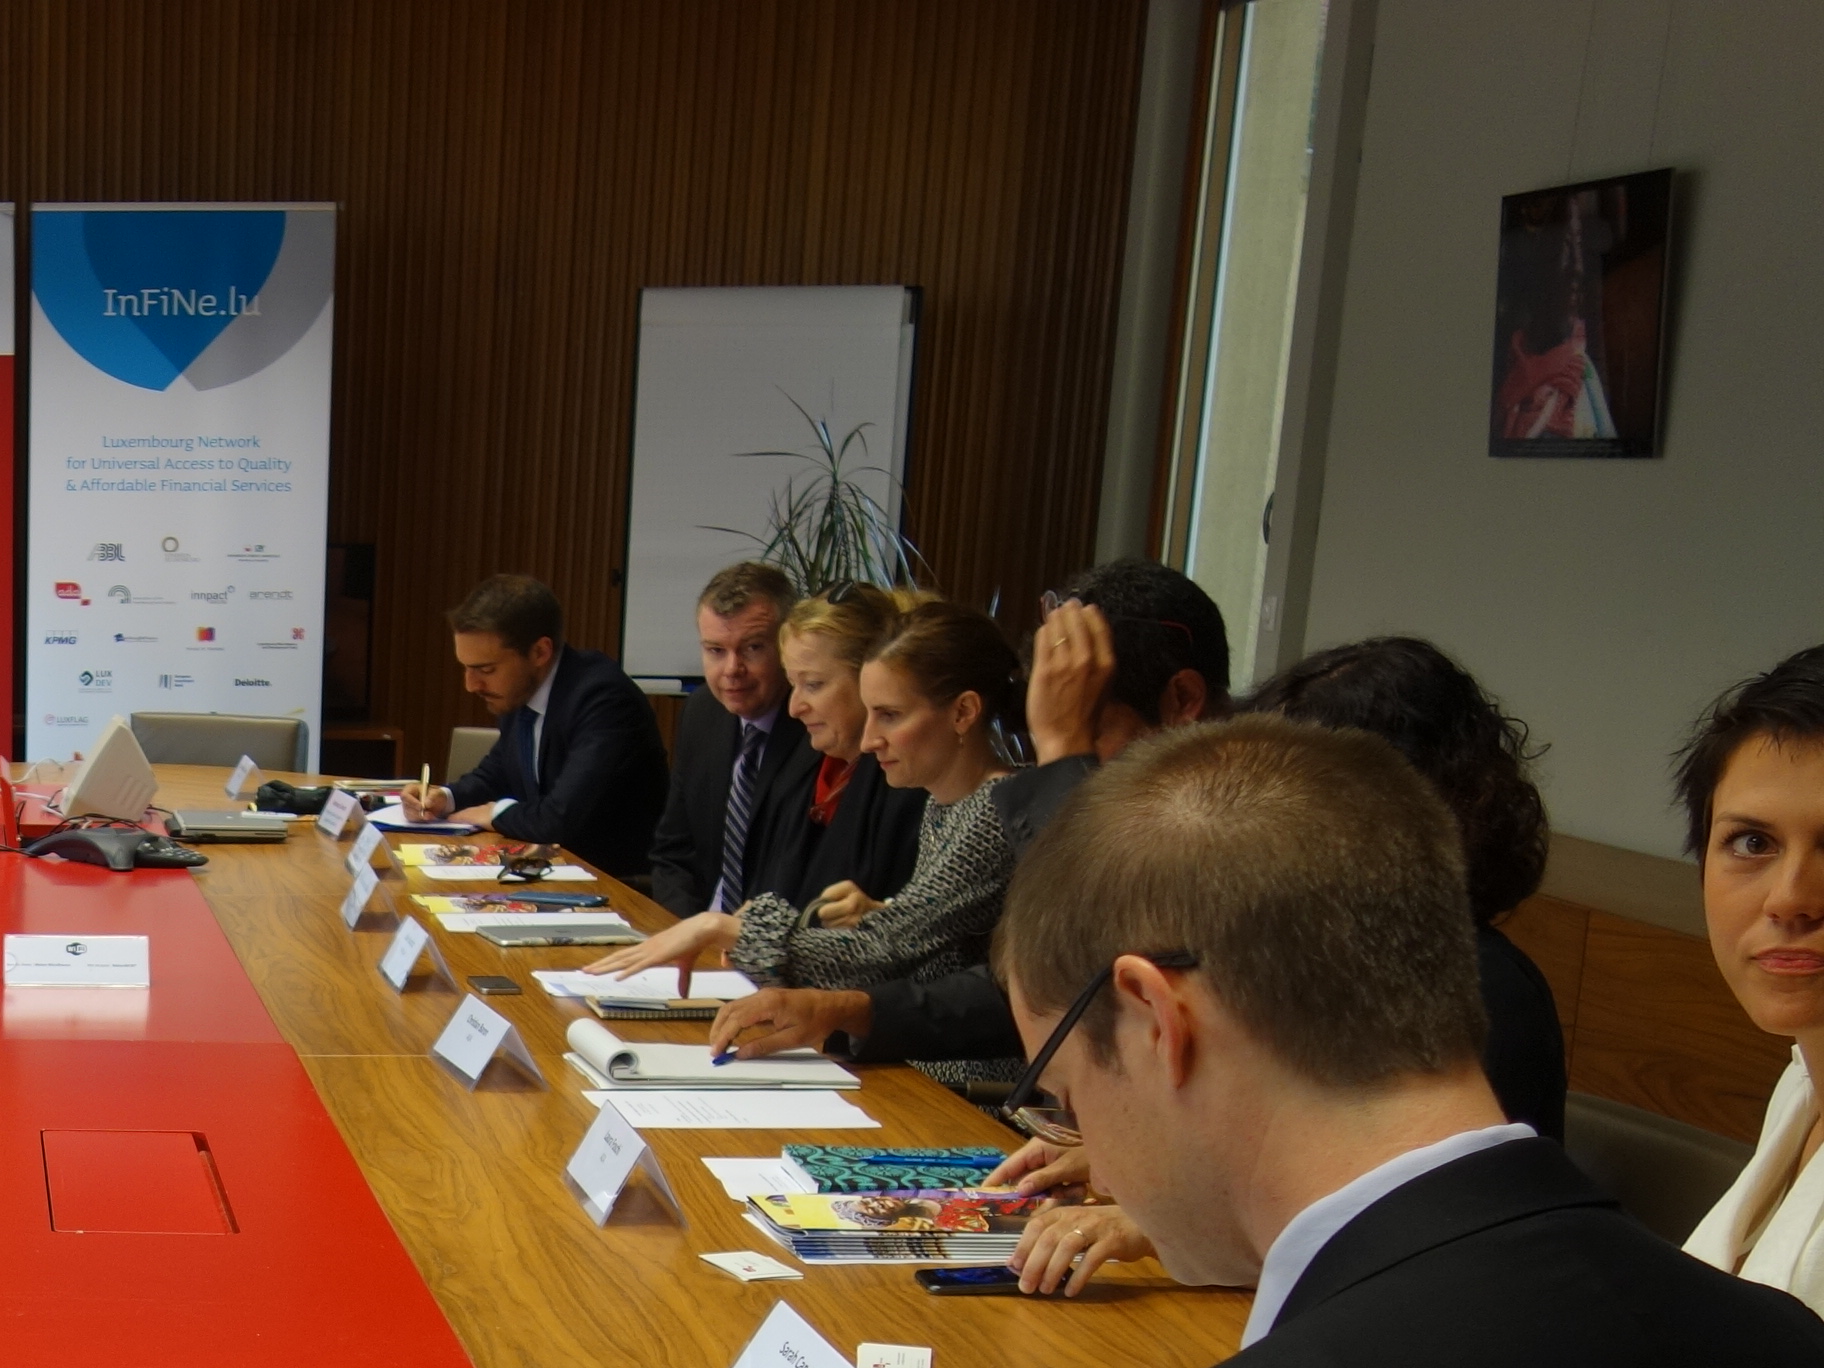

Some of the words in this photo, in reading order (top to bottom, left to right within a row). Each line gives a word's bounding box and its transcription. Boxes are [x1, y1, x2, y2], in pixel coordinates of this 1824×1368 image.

[102, 286, 263, 317] InFiNe.lu
[102, 435, 194, 452] Luxembourg
[197, 435, 261, 449] Network
[66, 456, 86, 470] for
[90, 456, 160, 470] Universal
[164, 457, 215, 470] Access
[218, 458, 234, 470] to
[237, 457, 292, 473] Quality
[66, 479, 77, 491] &
[80, 478, 157, 491] Affordable
[161, 478, 227, 491] Financial
[231, 479, 292, 492] Services
[44, 635, 78, 645] KPMG
[779, 1341, 800, 1365] Sarah
